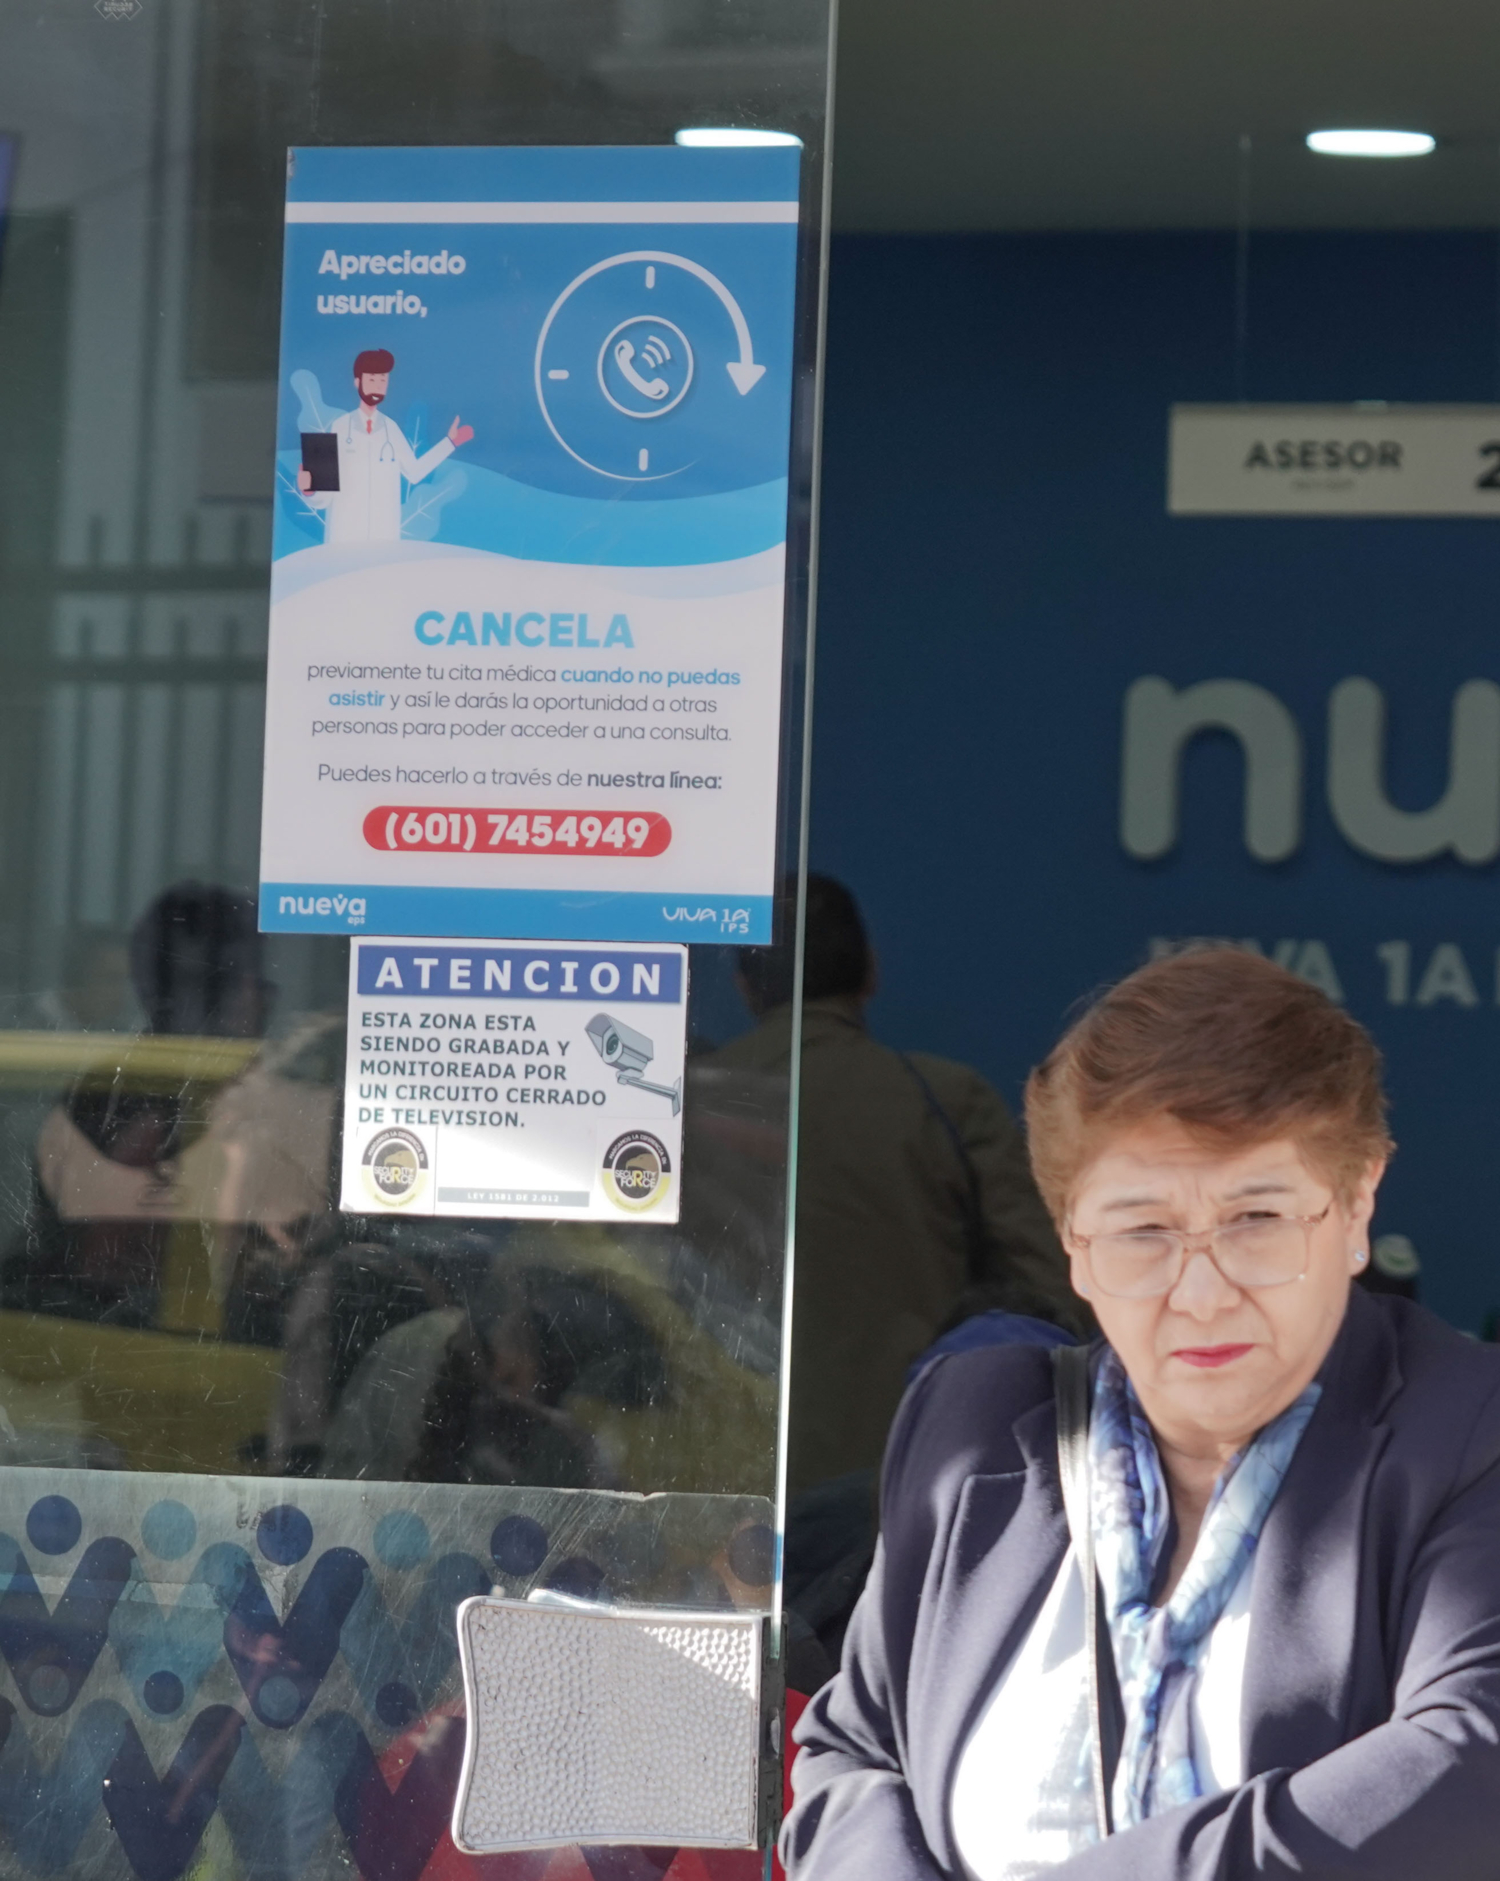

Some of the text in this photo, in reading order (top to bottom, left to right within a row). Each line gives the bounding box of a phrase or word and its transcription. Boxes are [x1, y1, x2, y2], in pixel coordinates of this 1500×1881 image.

[319, 250, 466, 280] Apreciado
[317, 290, 427, 317] usuario,
[1245, 441, 1403, 471] ASESOR
[414, 611, 634, 648] CANCELA
[308, 664, 740, 688] previamente tu cita médica cuando no puedas
[329, 690, 717, 713] asistir y así le darás la oportunidad a otras
[312, 720, 732, 741] personas para poder acceder a una consulta.
[319, 764, 721, 789] Puedes hacerlo a través de nuestra línea:
[385, 813, 649, 849] (601) 7454949
[279, 894, 366, 915] nueva
[663, 907, 749, 922] VIVA 1A
[348, 917, 365, 925] eps
[721, 923, 749, 933] IPS
[375, 958, 660, 995] ATENCION
[1378, 939, 1478, 1008] 1A
[362, 1012, 536, 1031] ESTA ZONA ESTA
[361, 1036, 570, 1056] SIENDO GRABADA Y
[361, 1060, 566, 1080] MONITOREADA POR
[360, 1084, 606, 1106] UN CIRCUITO CERRADO
[359, 1107, 524, 1127] DE TELEVISION.
